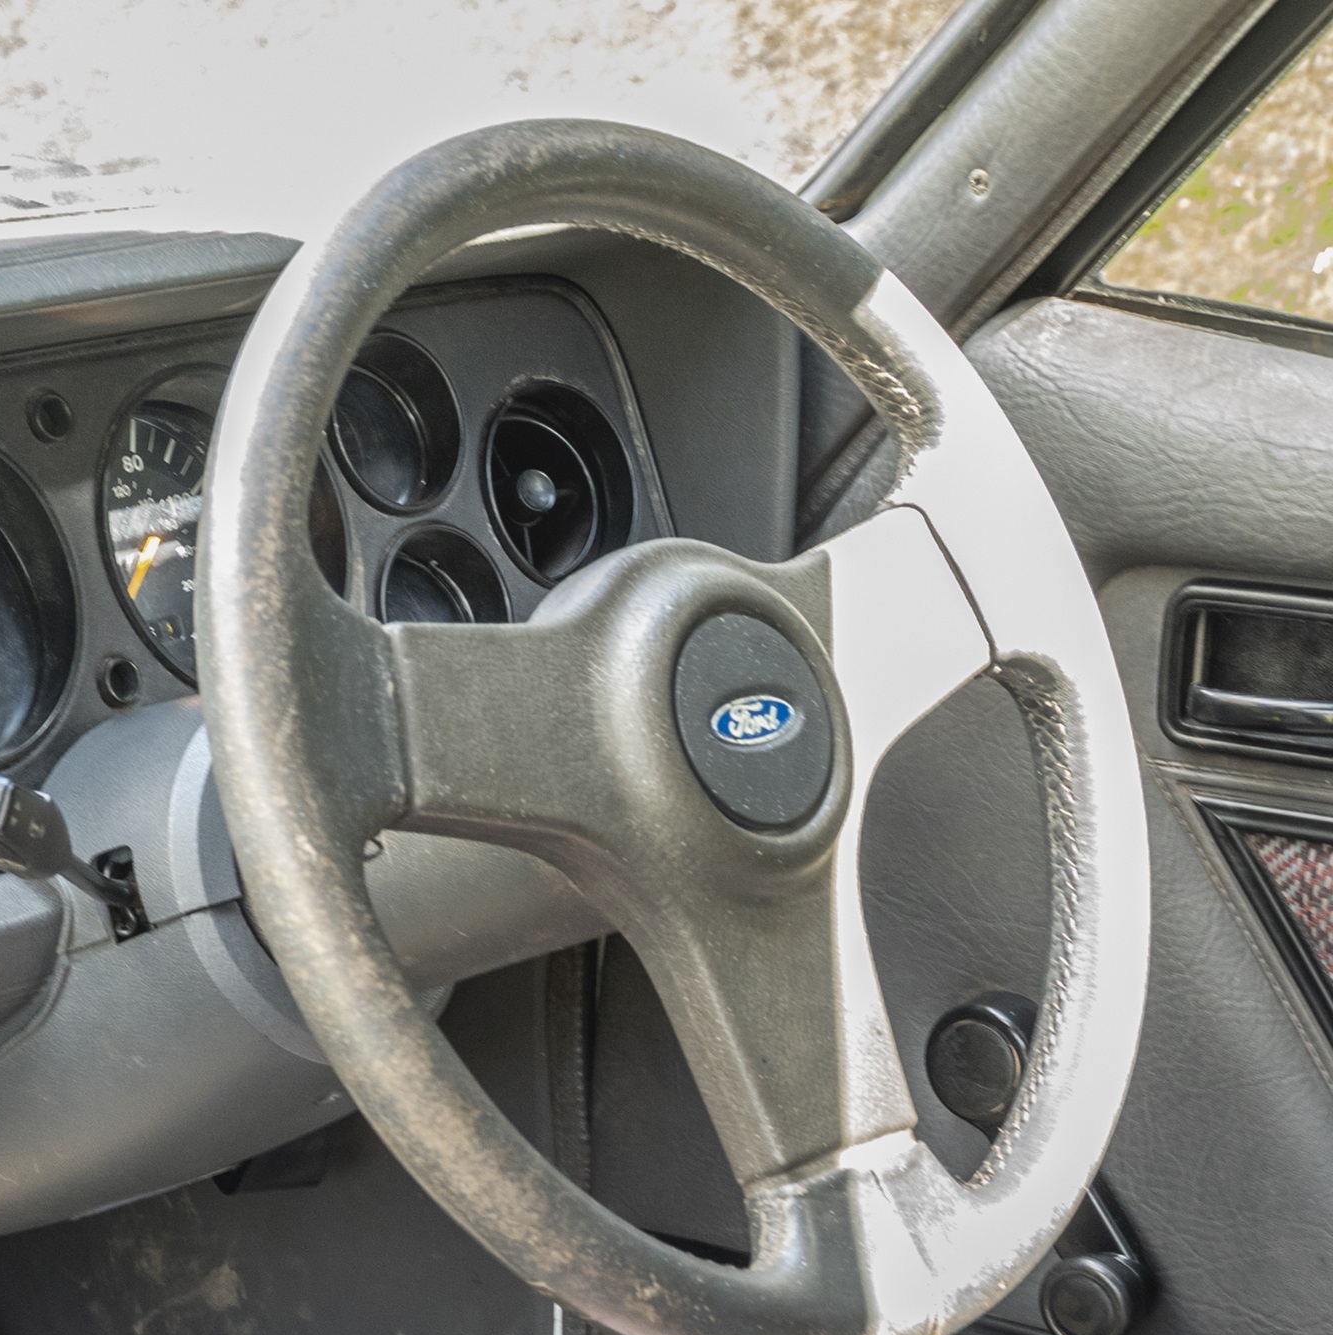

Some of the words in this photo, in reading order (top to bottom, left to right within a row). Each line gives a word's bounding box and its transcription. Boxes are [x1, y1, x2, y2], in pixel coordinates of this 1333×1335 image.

[121, 454, 145, 474] 80
[112, 484, 132, 499] 120
[181, 579, 195, 593] 20
[729, 702, 779, 737] Ford
